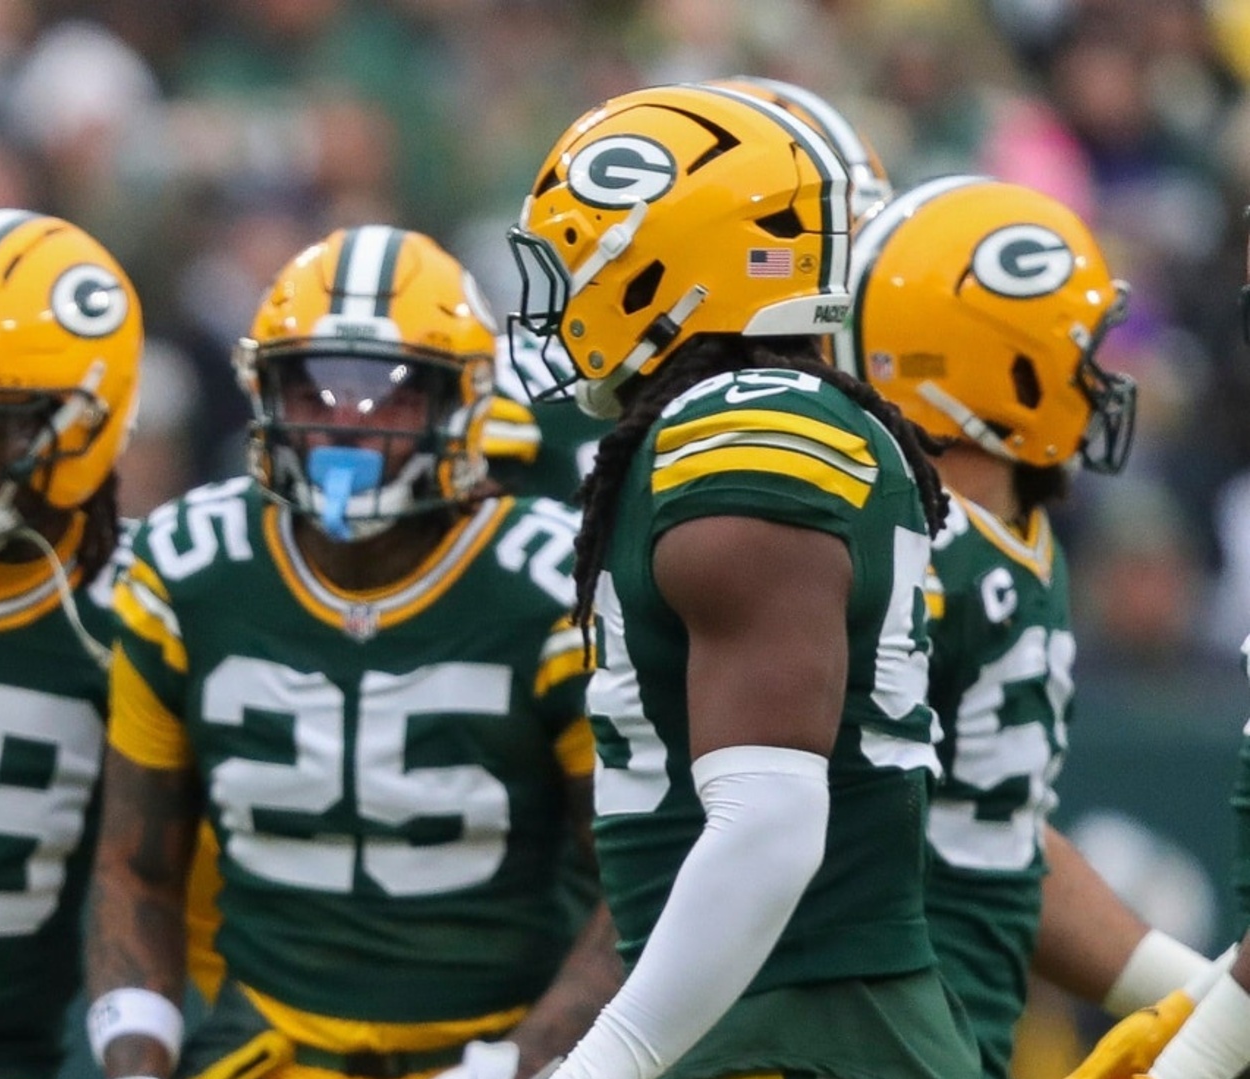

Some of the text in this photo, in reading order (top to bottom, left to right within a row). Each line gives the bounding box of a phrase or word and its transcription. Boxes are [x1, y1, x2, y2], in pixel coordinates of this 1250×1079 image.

[568, 135, 675, 207] G
[973, 224, 1072, 298] G
[51, 264, 128, 336] G
[202, 655, 512, 897] 25
